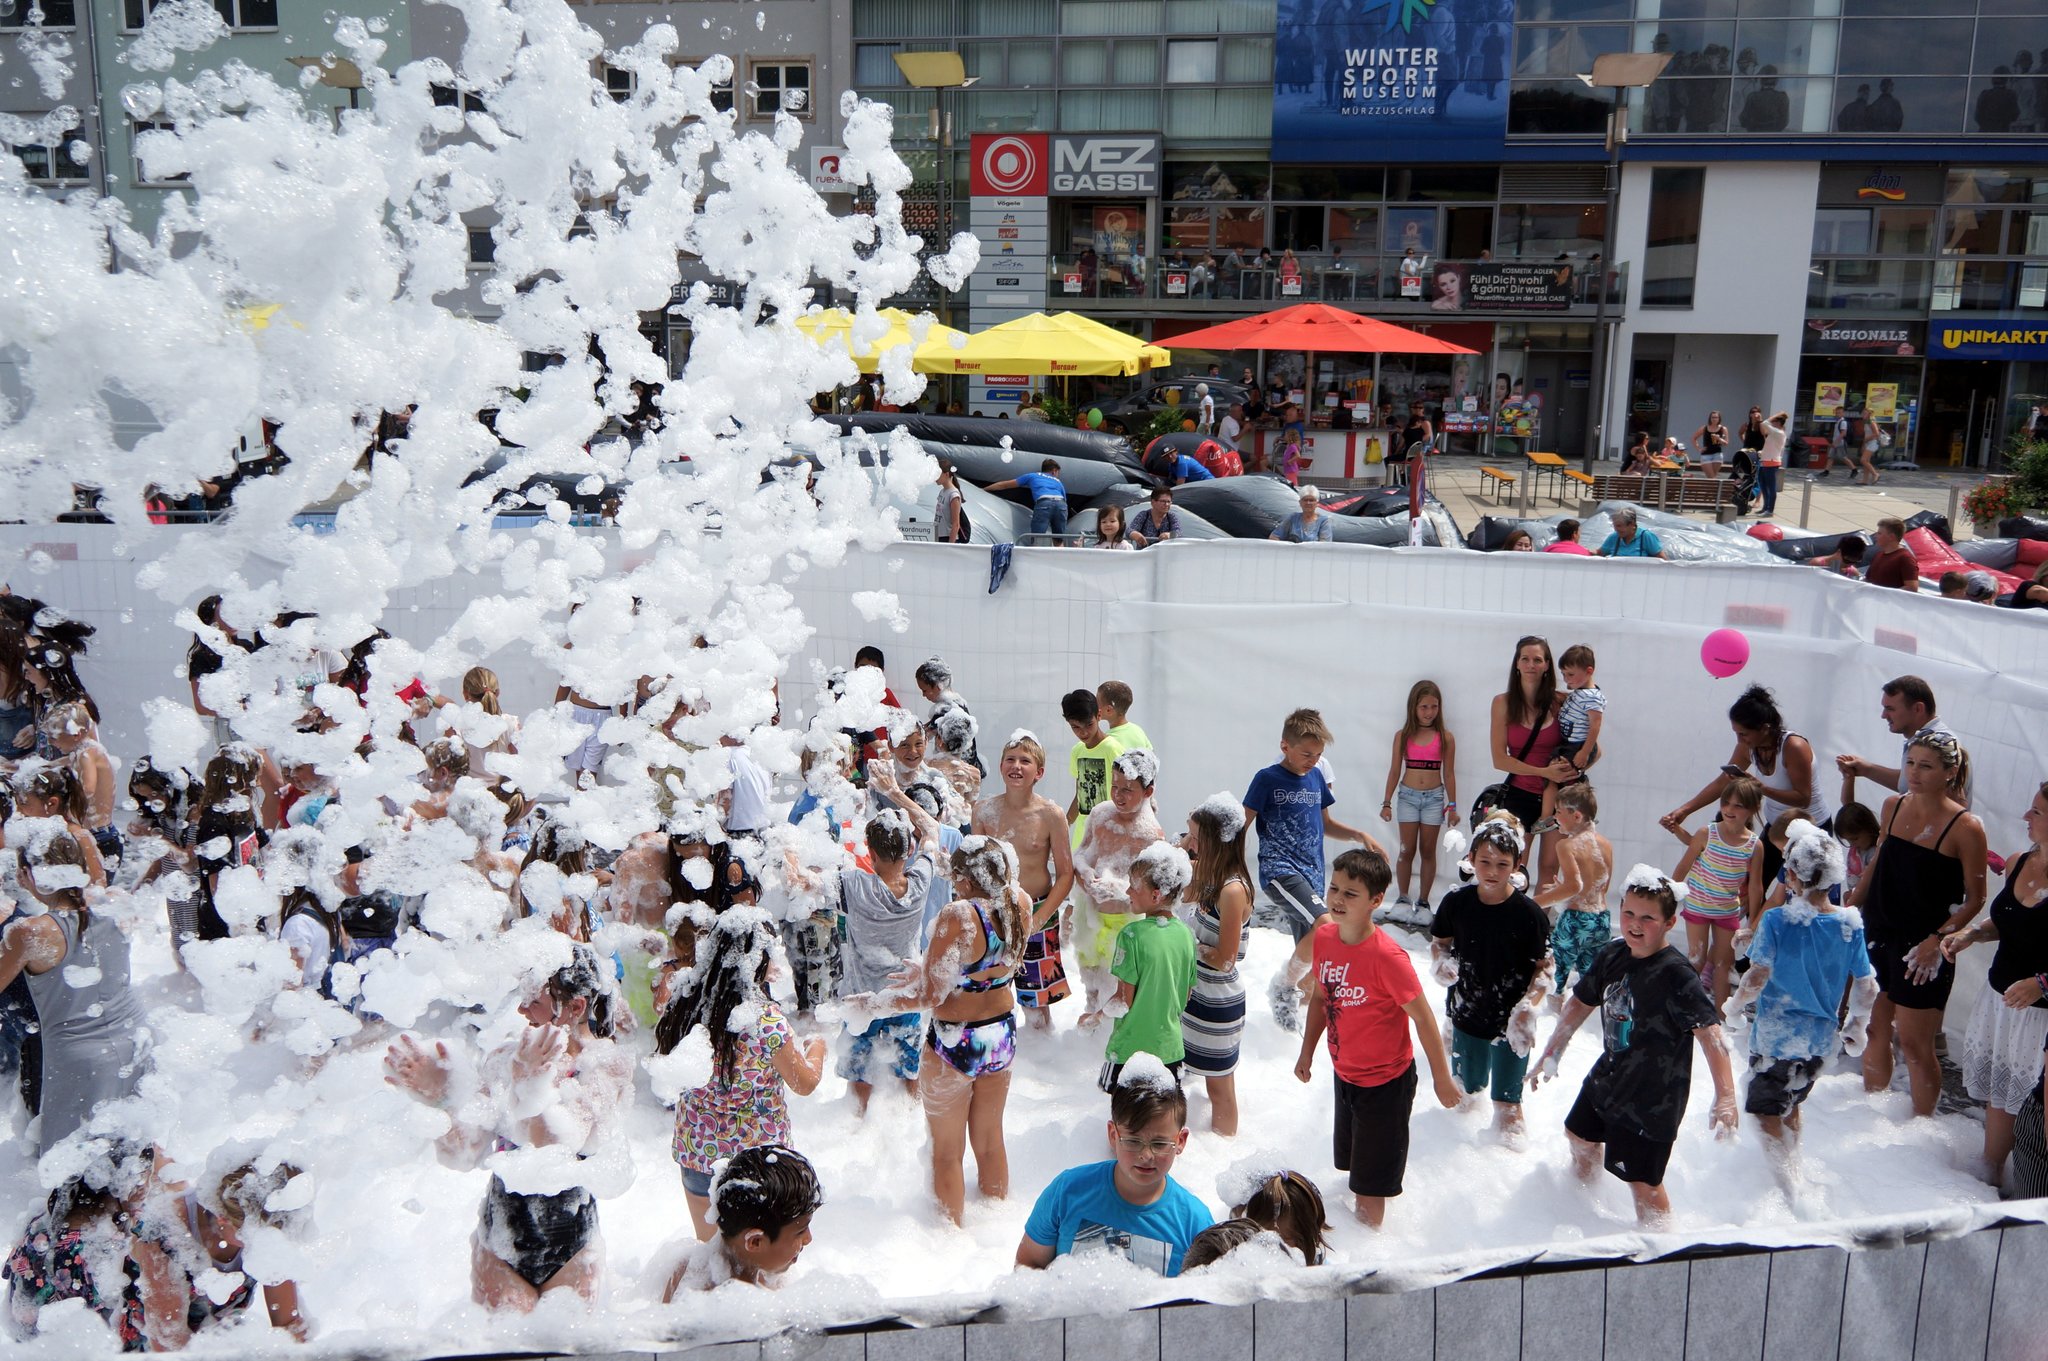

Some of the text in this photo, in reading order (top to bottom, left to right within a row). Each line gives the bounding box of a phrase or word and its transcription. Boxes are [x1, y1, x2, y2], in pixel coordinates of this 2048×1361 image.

[1345, 48, 1438, 66] WINTER
[1343, 67, 1438, 86] SPORT
[1343, 86, 1436, 98] MUSEUM
[1341, 106, 1436, 115] MÜRZZUSCHLAG
[1054, 139, 1155, 172] MEZ
[1054, 174, 1155, 191] GASSL
[1866, 168, 1901, 189] dm
[1470, 275, 1543, 284] Fühl Dich wohl
[1471, 284, 1478, 293] &
[1510, 285, 1523, 293] Dir
[1525, 286, 1548, 294] was!
[1820, 330, 1908, 341] REGIONALE
[1943, 330, 2048, 349] UNIMARKT
[1321, 960, 1350, 986] FEEL
[1334, 986, 1365, 999] GOOD
